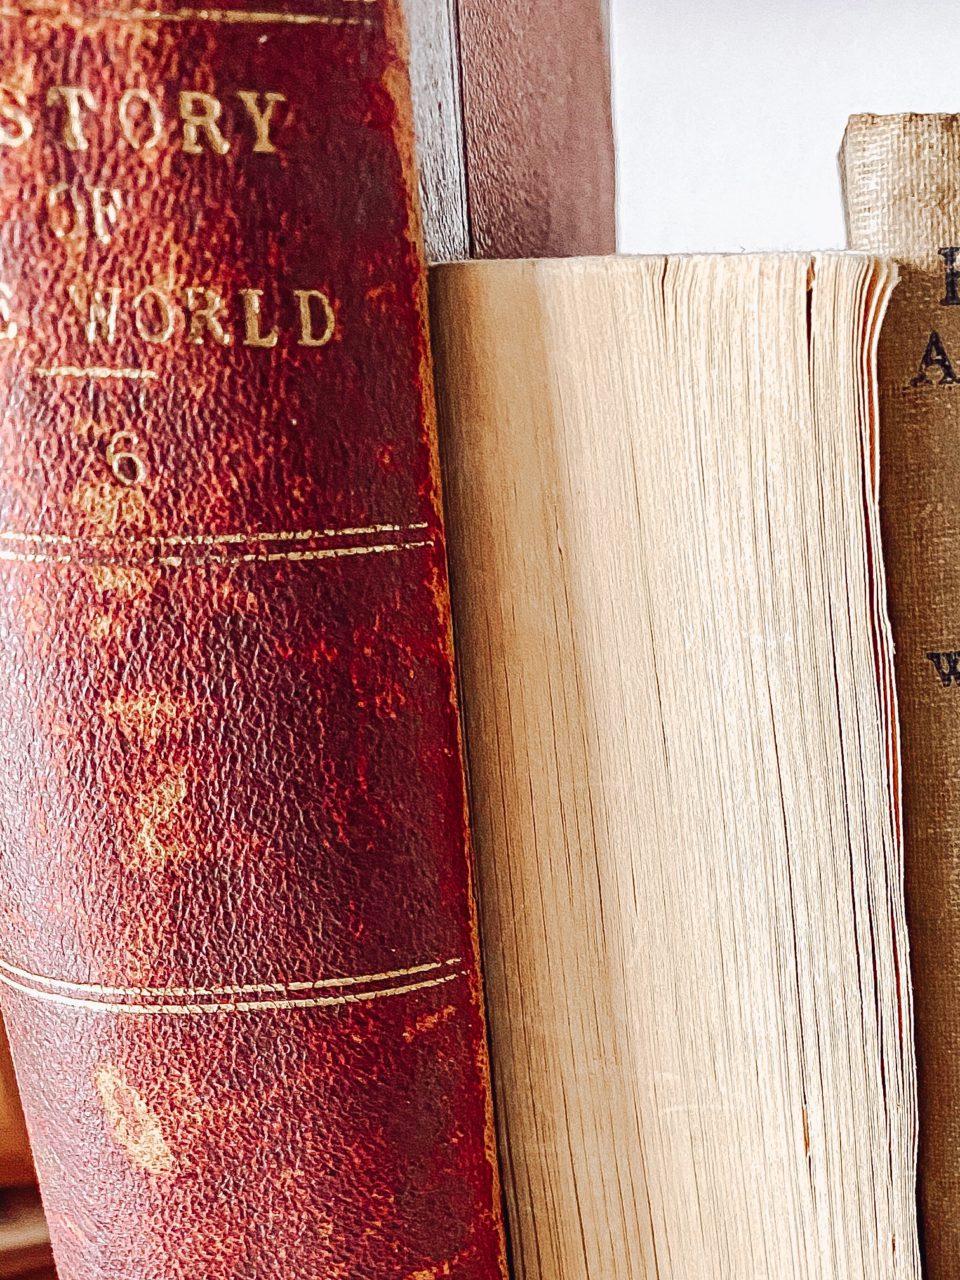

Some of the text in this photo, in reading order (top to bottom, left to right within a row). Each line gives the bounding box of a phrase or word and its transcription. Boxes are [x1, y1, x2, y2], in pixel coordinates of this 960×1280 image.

[0, 86, 286, 154] STORY
[48, 184, 122, 244] OF
[72, 286, 338, 349] WORLD
[106, 430, 146, 486] 6
